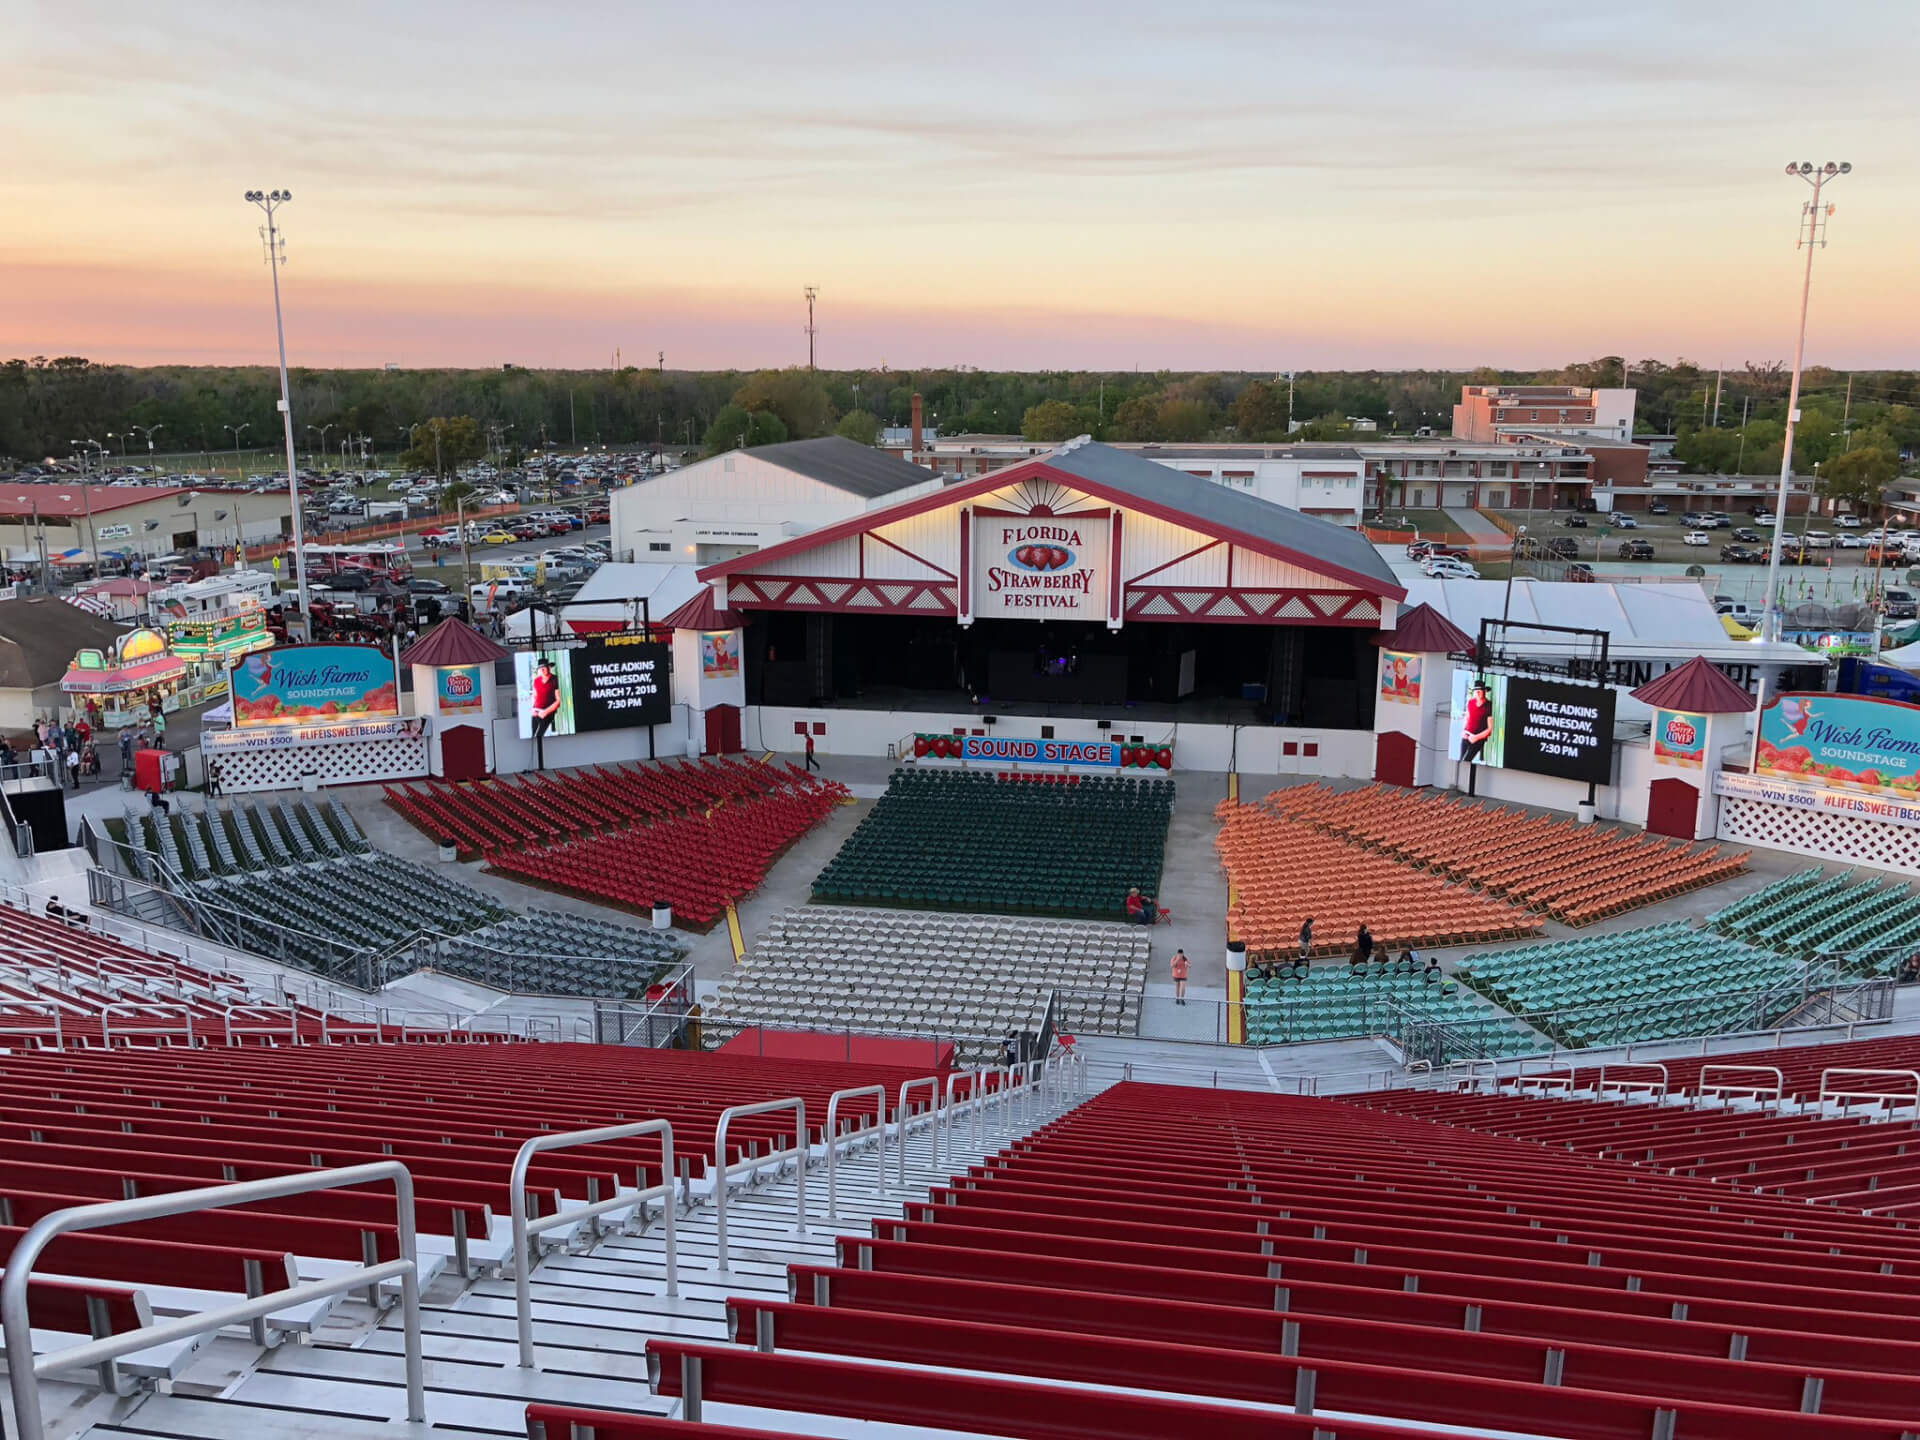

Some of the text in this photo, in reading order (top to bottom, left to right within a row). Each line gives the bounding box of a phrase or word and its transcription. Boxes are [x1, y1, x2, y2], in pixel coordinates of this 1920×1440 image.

[1002, 526, 1082, 546] FLORIDA
[988, 567, 1095, 594] STRAWBERRY
[1004, 594, 1079, 608] FESTIVAL
[590, 660, 655, 674] TRACE ADKINS
[274, 665, 370, 688] Wish Farms
[594, 673, 652, 686] WEDNESDAY,
[287, 687, 356, 699] SOUNDSTAGE
[591, 685, 657, 699] MARCH 7, 2018
[607, 698, 642, 709] 7:30 PM
[1526, 699, 1598, 719] TRACE ADKINS
[300, 723, 397, 740] #LIFEISSWEETBECAUSE
[1529, 713, 1593, 734] WEDNESDAY,
[246, 738, 268, 747] WIN
[269, 736, 293, 745] $500!
[1523, 726, 1598, 747] MARCH 7, 2018
[1810, 720, 1863, 746] Wish
[967, 739, 1112, 762] SOUND STAGE
[1540, 742, 1579, 758] 7:30 PM
[1820, 747, 1907, 768] SOUNDSTAGE
[1761, 789, 1786, 801] WIN
[1788, 793, 1816, 807] $500!
